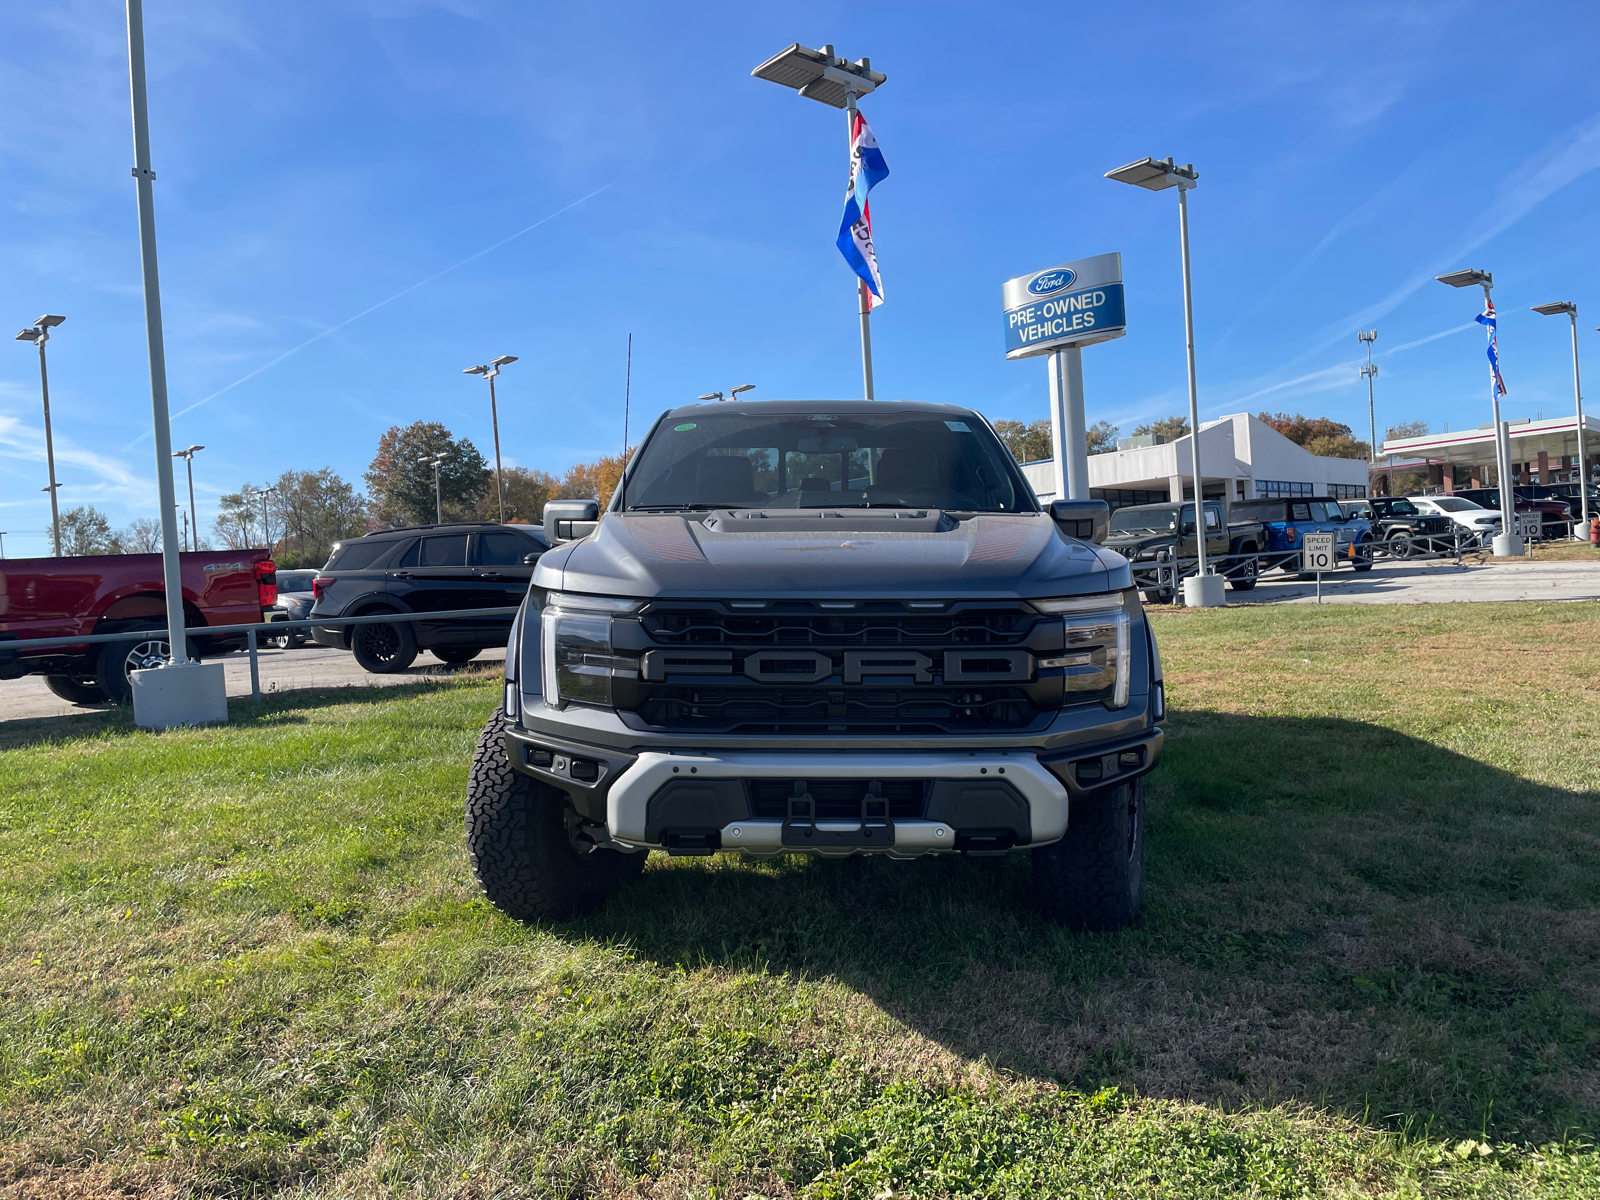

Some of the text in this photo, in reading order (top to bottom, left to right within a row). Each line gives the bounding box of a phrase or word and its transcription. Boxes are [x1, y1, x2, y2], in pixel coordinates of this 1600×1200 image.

[1036, 273, 1064, 291] Ford
[1009, 291, 1106, 329] PRE-OWNED
[1019, 311, 1095, 343] VEHICLES
[1524, 525, 1538, 534] 10
[1309, 553, 1328, 567] 10
[641, 649, 1035, 684] FORD
